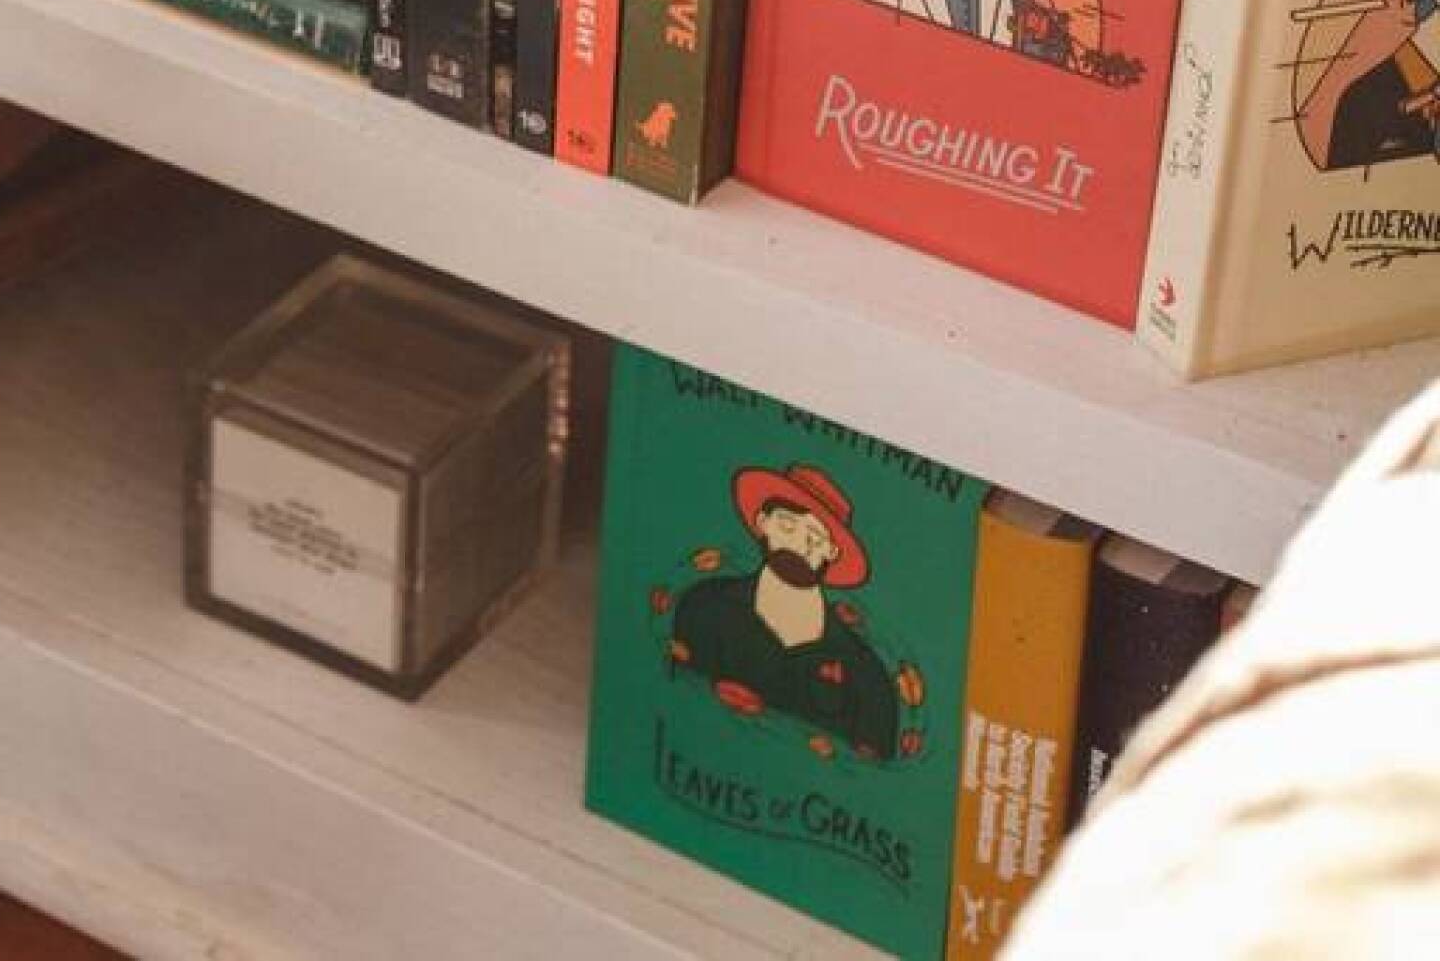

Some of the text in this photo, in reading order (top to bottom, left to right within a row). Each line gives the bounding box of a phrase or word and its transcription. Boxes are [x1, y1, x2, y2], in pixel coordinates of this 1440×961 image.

[816, 74, 1095, 202] ROUGHING IT
[654, 714, 759, 821] LEAVES
[800, 792, 912, 882] GRASS
